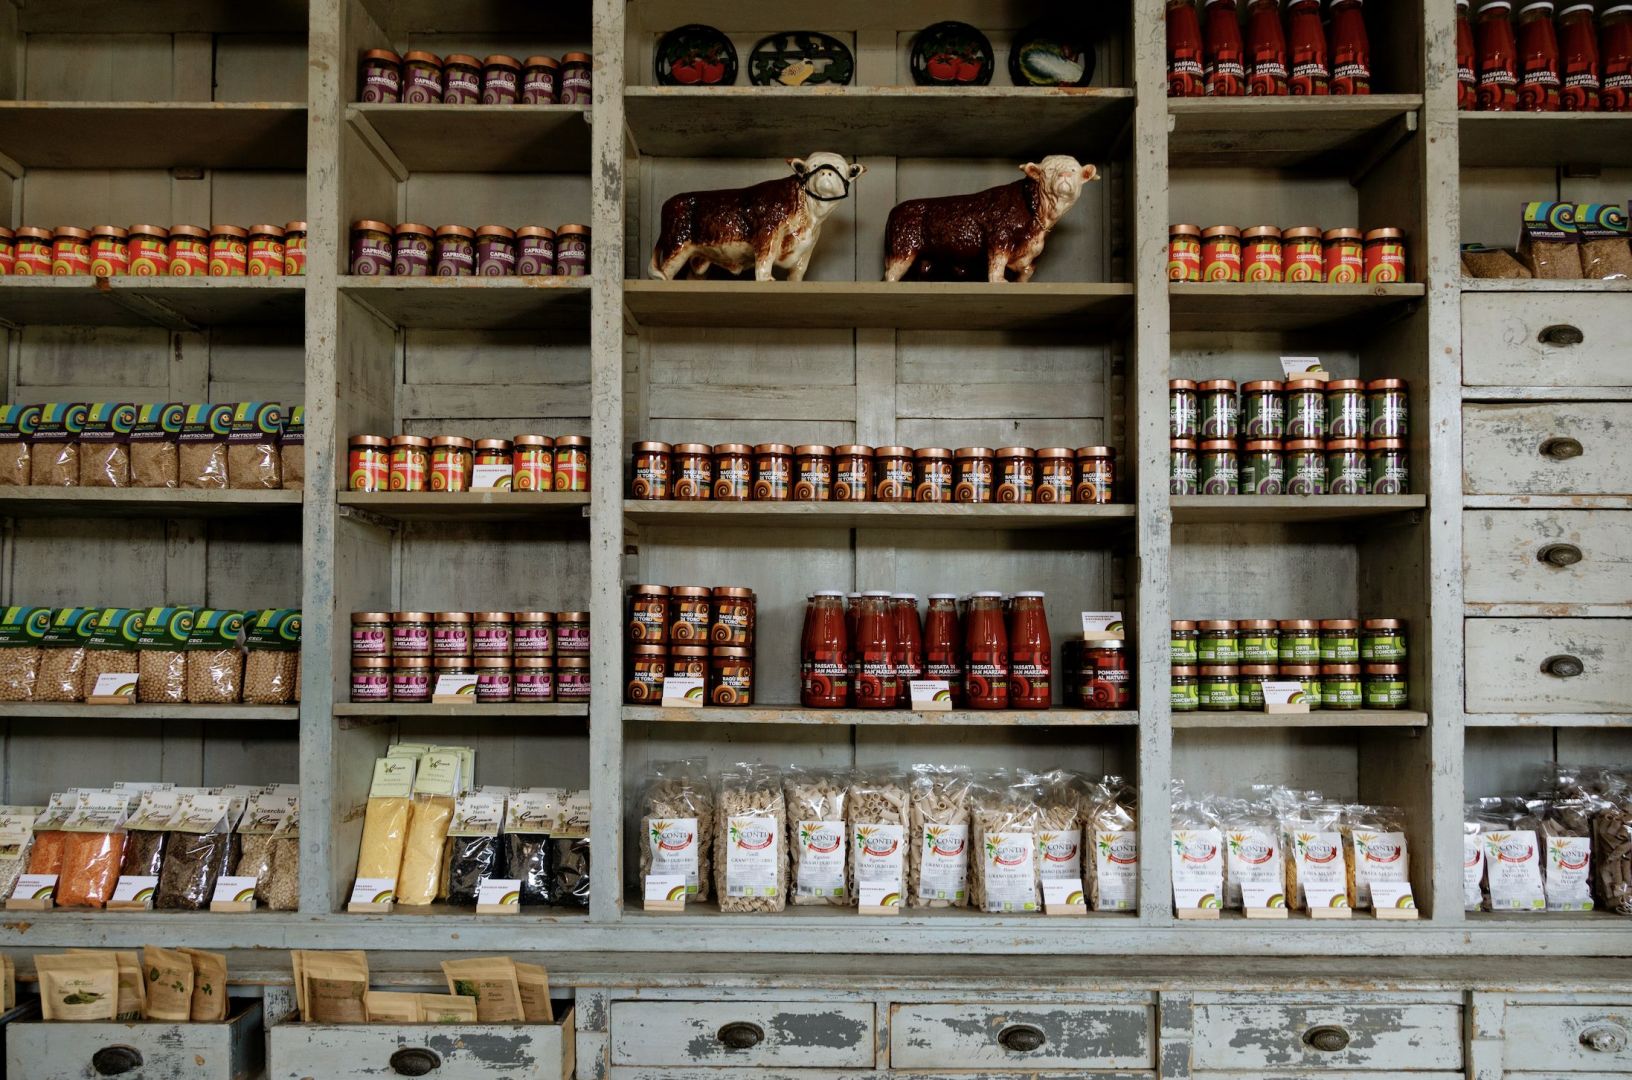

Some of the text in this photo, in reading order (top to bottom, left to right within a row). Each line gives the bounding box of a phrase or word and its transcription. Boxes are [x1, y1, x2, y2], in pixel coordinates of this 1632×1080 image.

[1174, 60, 1197, 68] PASSATA
[1256, 62, 1280, 70] PASSATA
[1294, 63, 1318, 72] PASSATA
[1334, 64, 1359, 74] PASSATA
[1481, 70, 1507, 79] PASSATA
[1565, 73, 1591, 82] PASSATA
[362, 247, 392, 258] CAPRICCIO
[397, 248, 427, 257] CAPRICCIO
[442, 252, 472, 261] CAPRICCIO
[193, 806, 213, 814] Roveja
[1047, 843, 1072, 851] CONTI
[1561, 850, 1585, 858] CONTI
